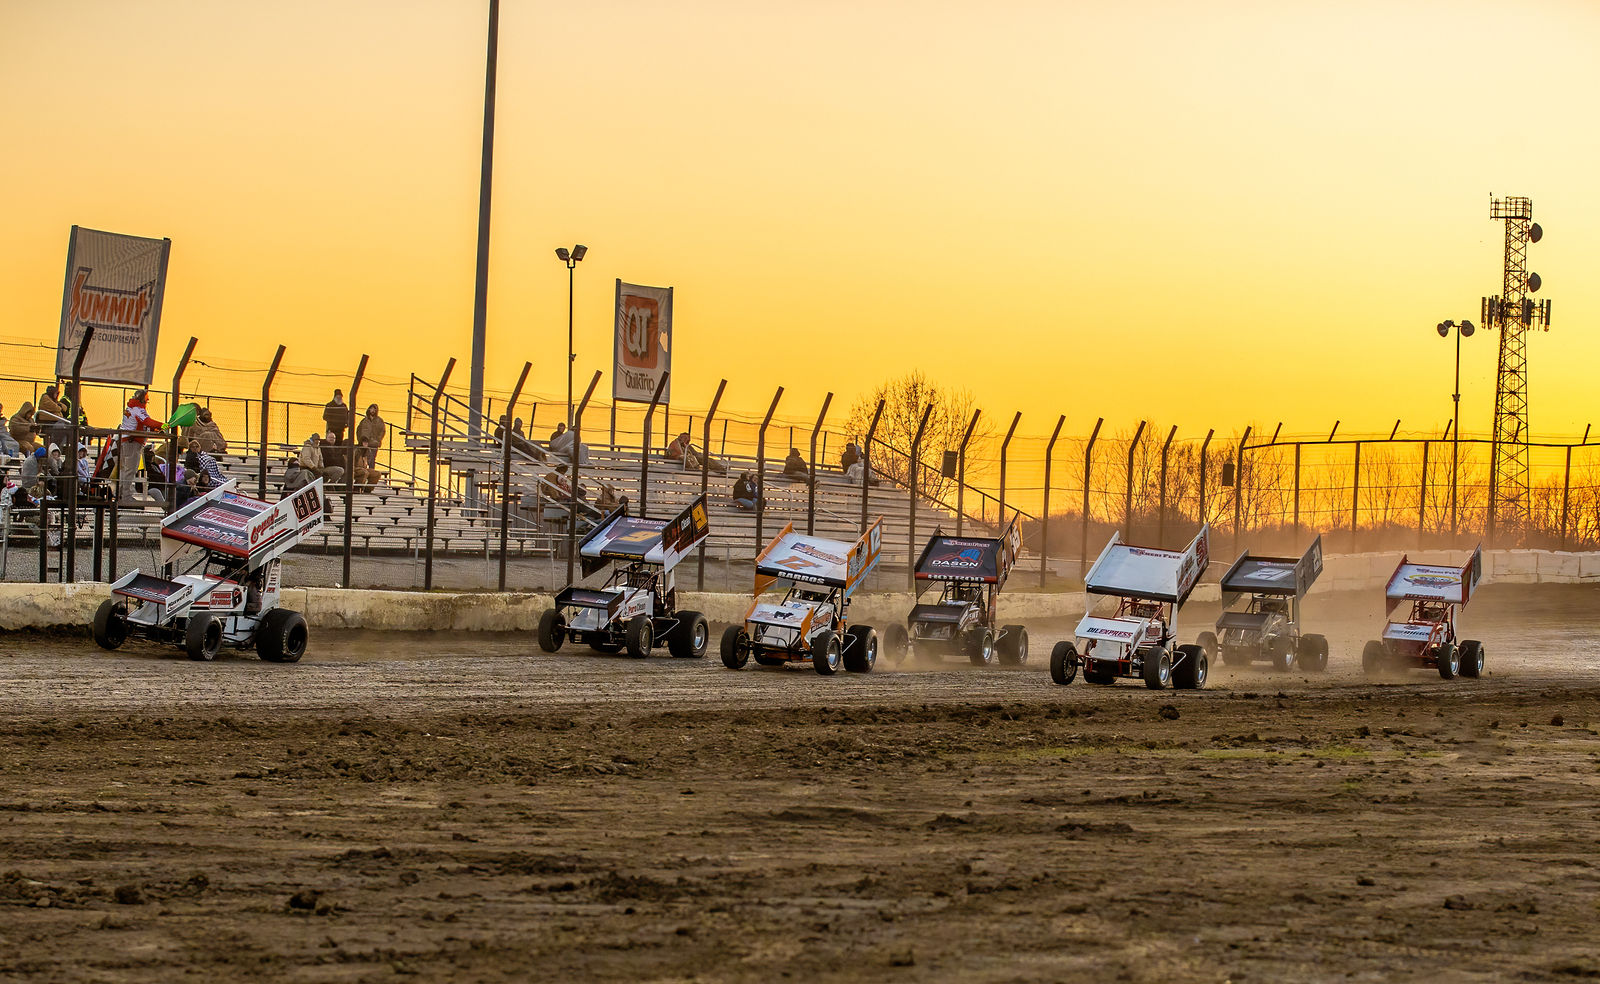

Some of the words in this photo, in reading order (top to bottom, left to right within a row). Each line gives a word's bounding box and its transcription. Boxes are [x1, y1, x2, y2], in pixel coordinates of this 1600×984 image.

[69, 271, 149, 329] SUMMIT
[97, 332, 141, 344] EQUIPMENT
[626, 305, 652, 356] QT
[625, 370, 655, 394] QuikTrip
[291, 486, 322, 522] 88
[932, 559, 978, 567] DASON
[777, 571, 825, 585] BARROS
